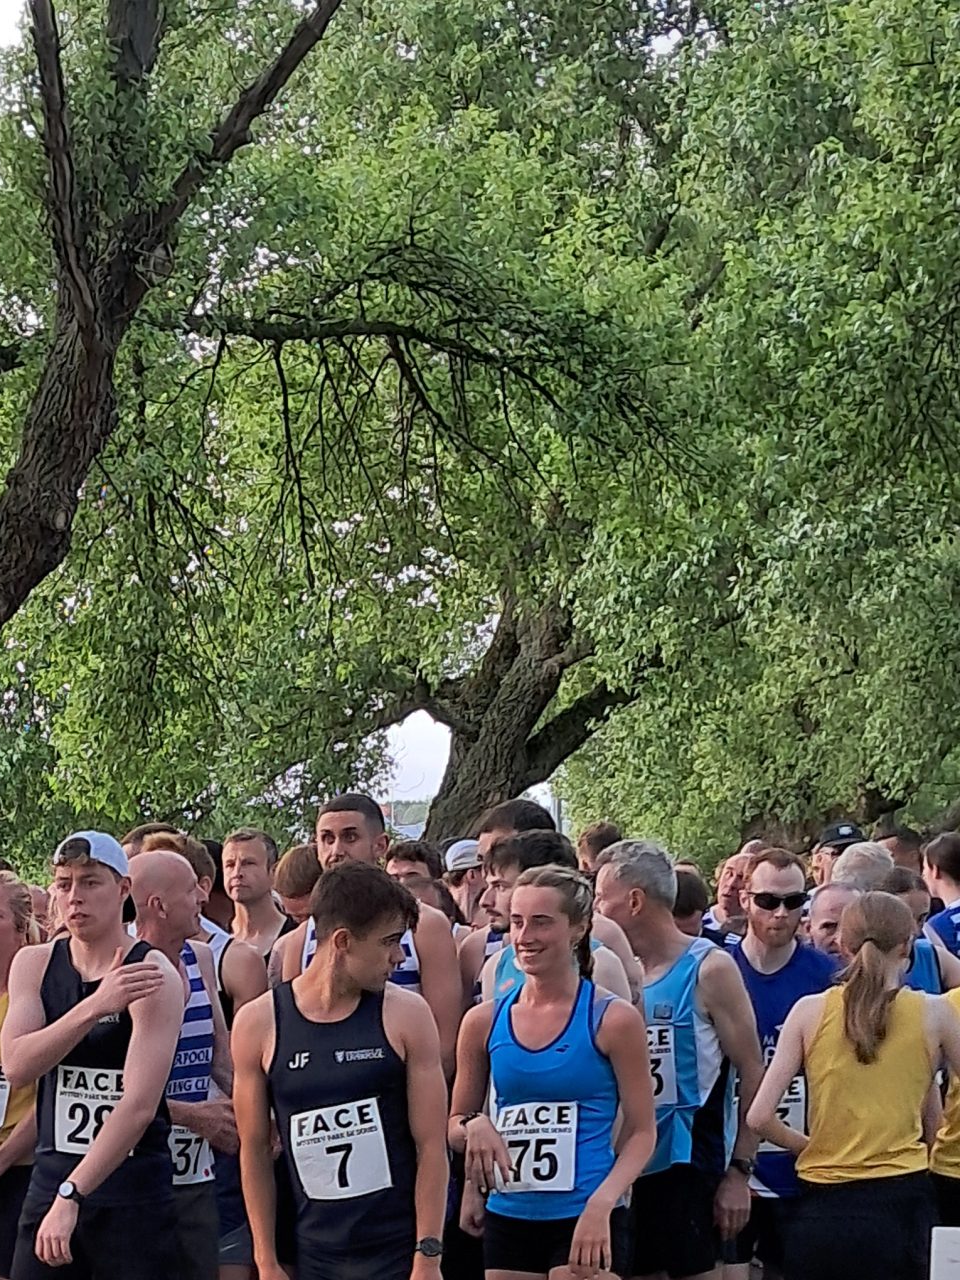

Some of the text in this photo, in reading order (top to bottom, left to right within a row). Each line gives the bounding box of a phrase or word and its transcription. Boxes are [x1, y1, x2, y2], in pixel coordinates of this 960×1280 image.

[289, 1052, 310, 1069] JF
[173, 1138, 205, 1176] 37
[324, 1142, 353, 1189] 7
[507, 1138, 558, 1183] 75
